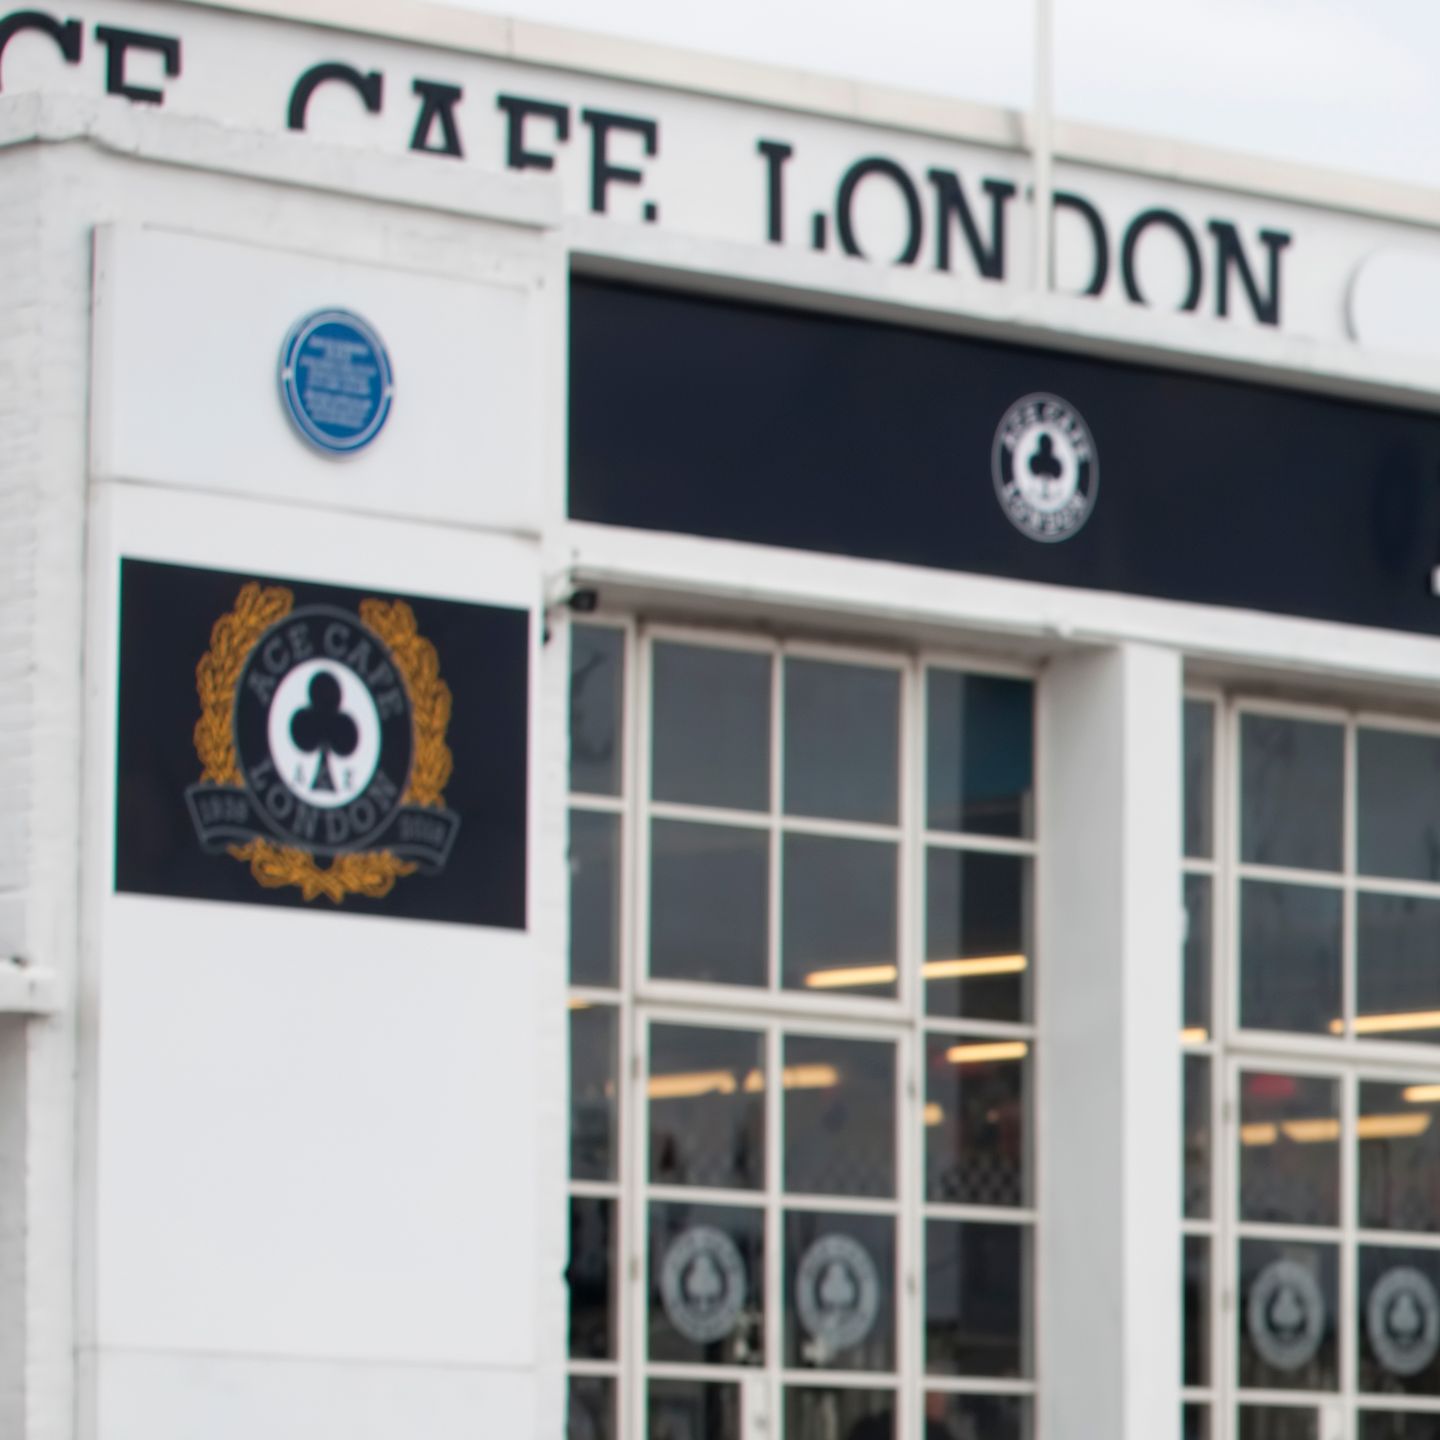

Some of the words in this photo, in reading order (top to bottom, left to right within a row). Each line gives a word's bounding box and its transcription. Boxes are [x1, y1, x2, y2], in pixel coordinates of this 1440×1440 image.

[756, 139, 1291, 326] LONDON
[246, 622, 311, 708] ACE
[322, 622, 404, 721] CAFE
[250, 755, 399, 843] LONDON
